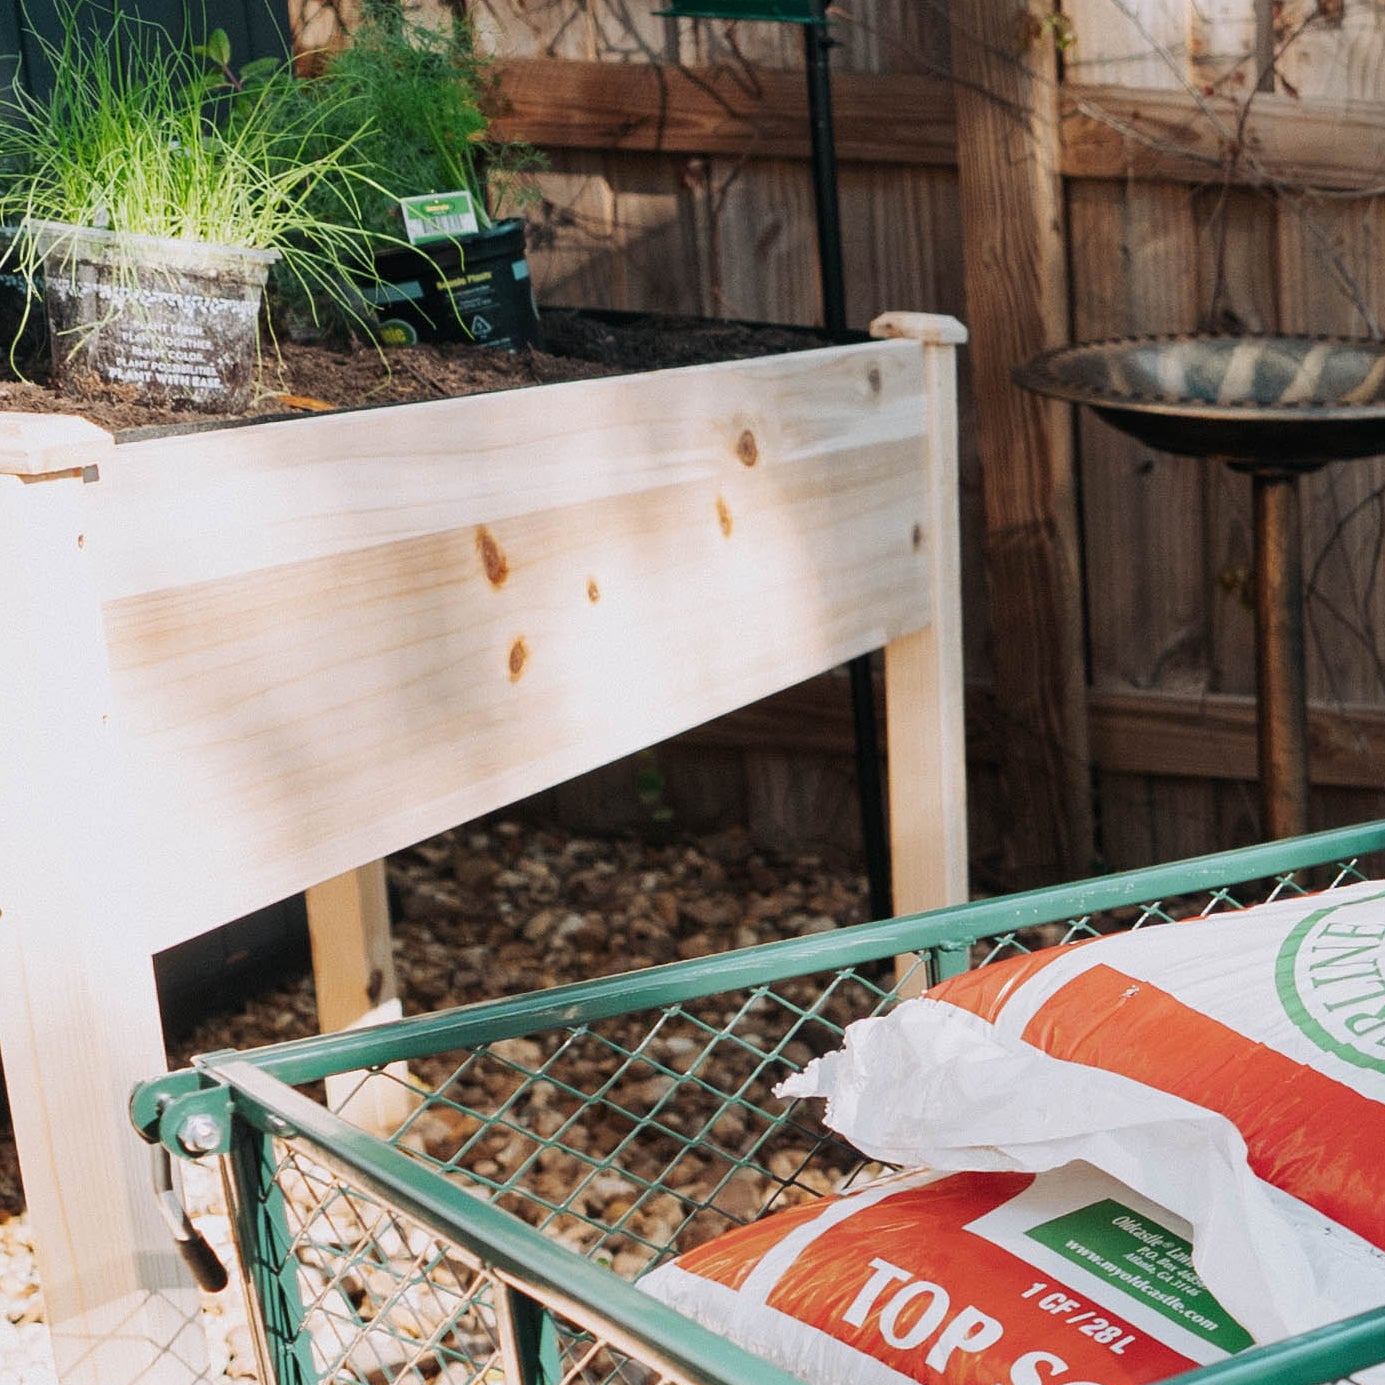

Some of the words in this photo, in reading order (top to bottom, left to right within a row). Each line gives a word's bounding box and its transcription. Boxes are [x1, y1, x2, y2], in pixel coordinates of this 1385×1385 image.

[108, 367, 153, 383] PLANT
[155, 372, 190, 387] WITH
[842, 1257, 1004, 1375] TOP
[1021, 1282, 1047, 1299] 1
[1038, 1293, 1080, 1315] CF
[1079, 1317, 1127, 1345] 28
[1065, 1239, 1219, 1331] www.myoldcastle.com
